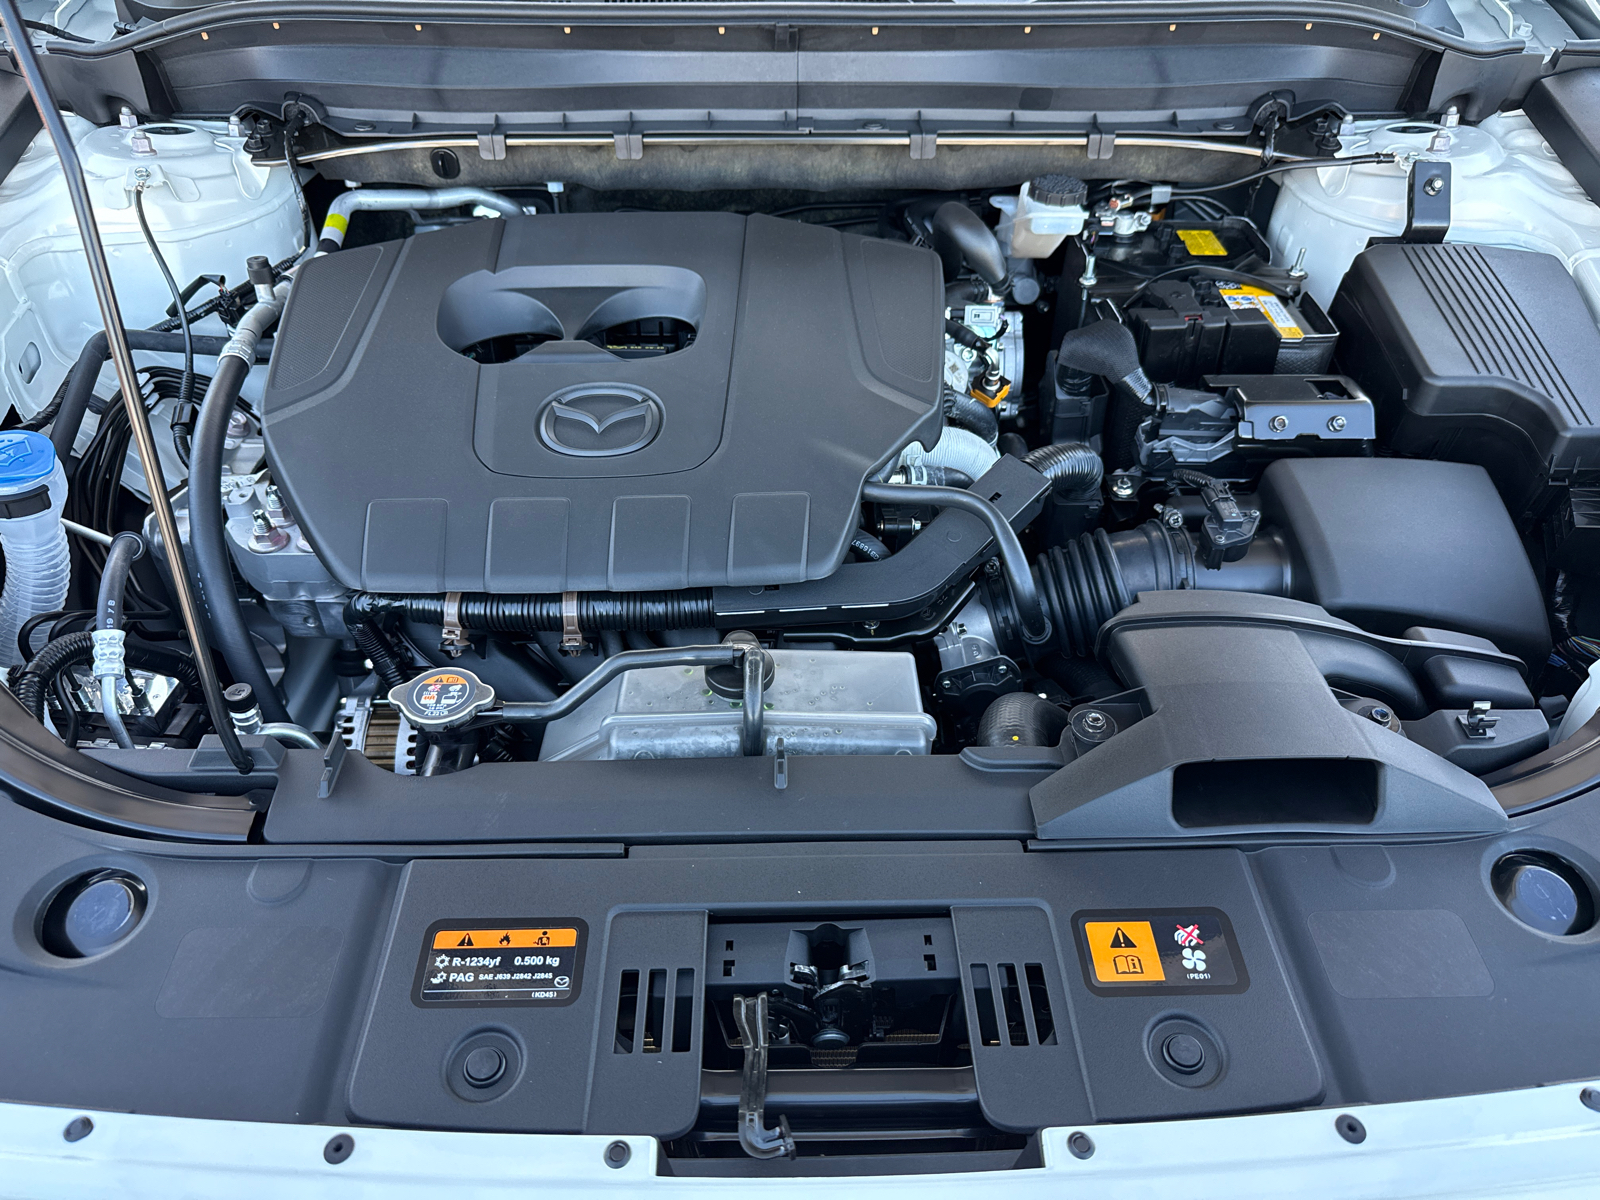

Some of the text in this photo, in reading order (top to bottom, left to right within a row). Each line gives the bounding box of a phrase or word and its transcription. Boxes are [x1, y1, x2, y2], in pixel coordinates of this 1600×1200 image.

[452, 955, 560, 968] R-1234yf 0.500 kg
[449, 972, 475, 982] PAG
